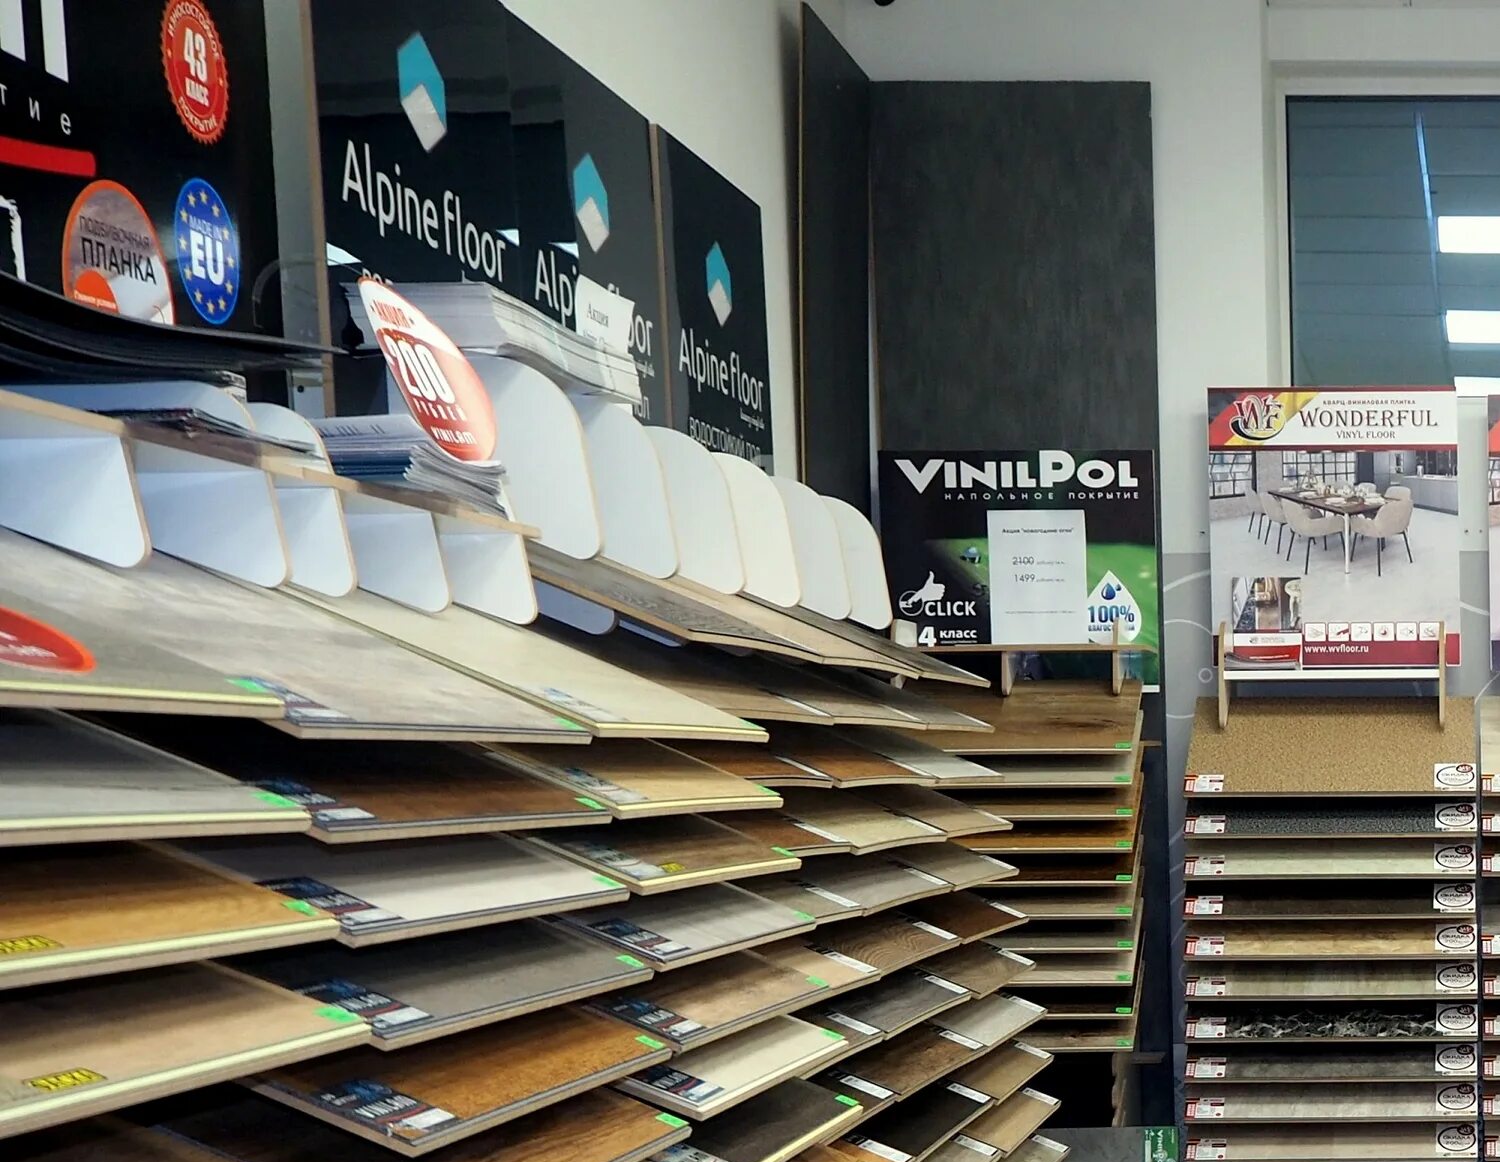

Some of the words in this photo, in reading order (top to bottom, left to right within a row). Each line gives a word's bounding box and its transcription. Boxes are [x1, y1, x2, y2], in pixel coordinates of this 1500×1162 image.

[183, 28, 208, 82] 43
[342, 139, 439, 253] Alpine
[443, 190, 506, 283] floor
[80, 236, 156, 285] ПЛАНКА
[190, 230, 225, 285] EU
[679, 328, 728, 395] Alpine
[730, 351, 764, 412] floor
[1300, 407, 1438, 428] WONDERFUL
[1336, 430, 1363, 439] VINYL
[1366, 431, 1396, 439] FLOOR
[944, 492, 1054, 500] НАПОЛЬНОЕ
[1068, 491, 1140, 500] ПОКРЫТИЕ
[1014, 574, 1035, 583] 1499
[924, 600, 977, 617] CLICK
[1088, 605, 1135, 623] 100%
[939, 628, 978, 639] класс
[1304, 644, 1369, 653] www.wvfloor.ru
